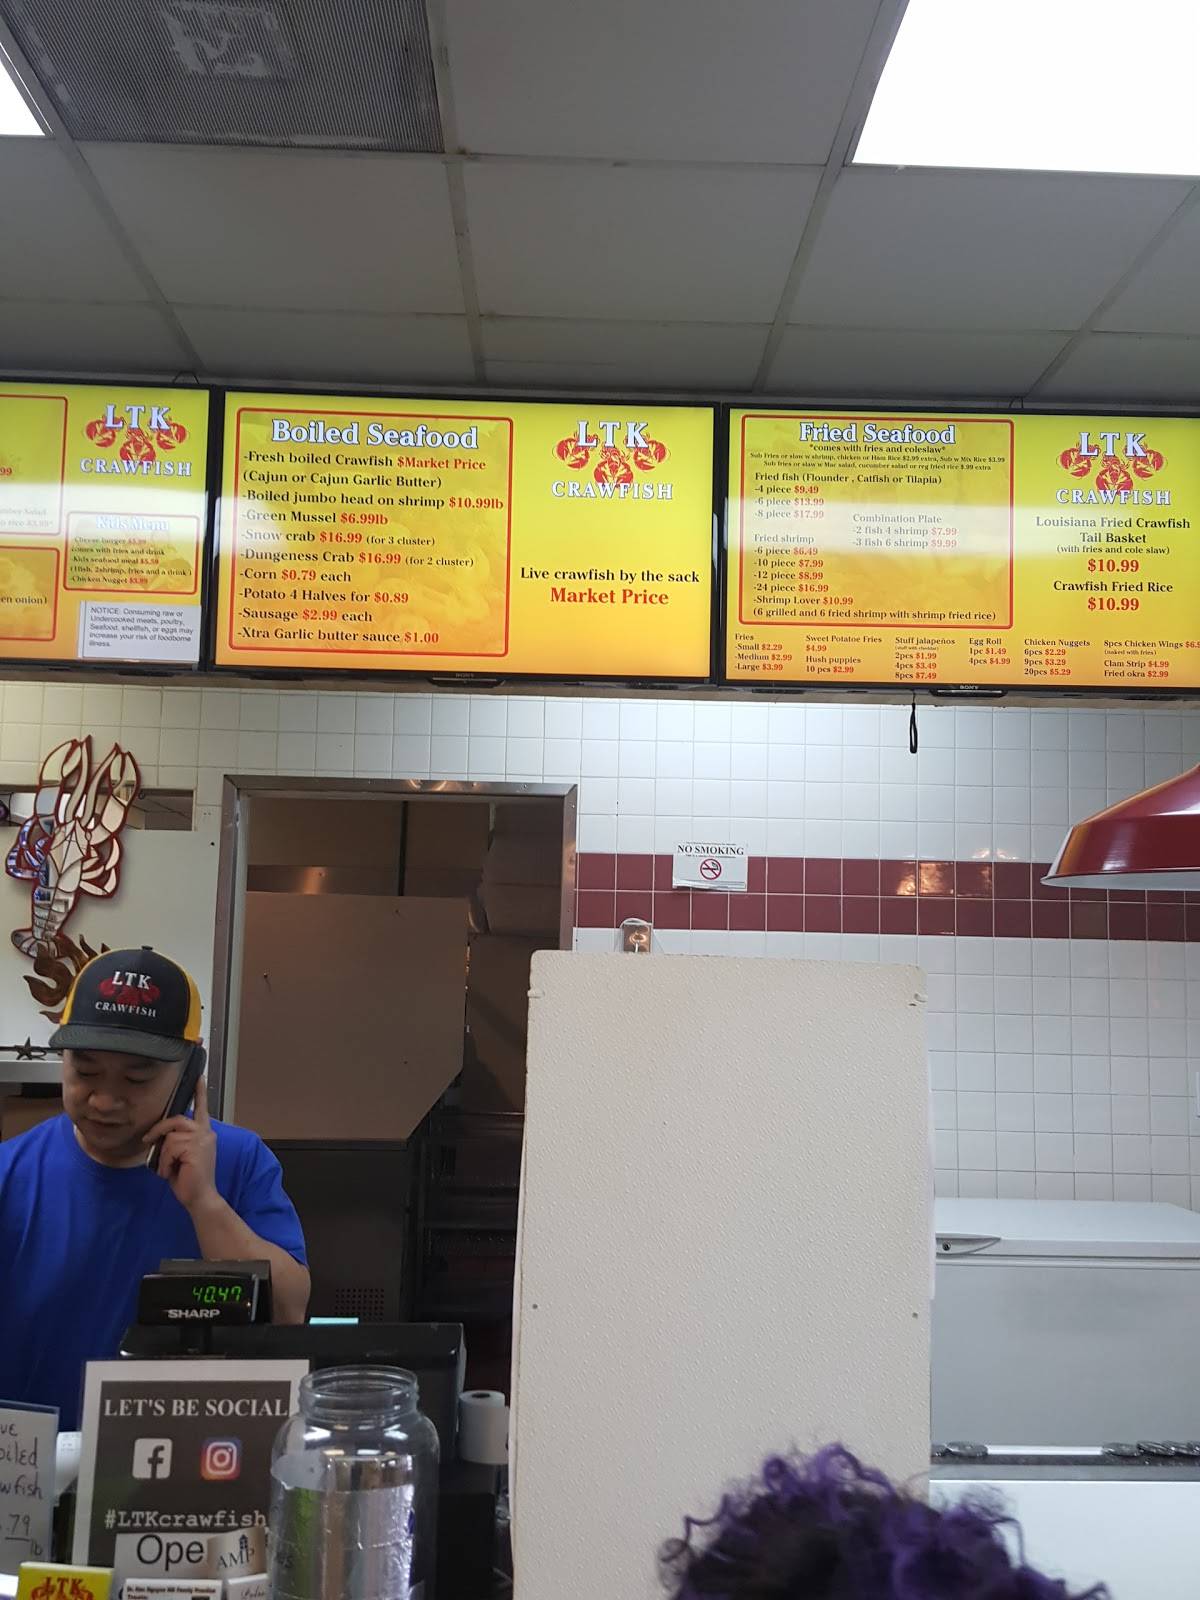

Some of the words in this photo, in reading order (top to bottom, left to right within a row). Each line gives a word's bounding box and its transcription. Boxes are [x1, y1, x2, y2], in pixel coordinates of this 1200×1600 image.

[105, 404, 172, 430] LTK
[272, 419, 359, 444] Boiled
[367, 424, 478, 449] Seafood
[576, 420, 650, 448] LTK
[800, 422, 857, 442] Fried
[863, 424, 956, 444] Seafood
[1080, 432, 1147, 458] LTK
[80, 458, 192, 476] CRAWFISH
[289, 452, 330, 463] boiled
[335, 454, 392, 466] Crawfish
[397, 456, 449, 469] $Market
[454, 457, 485, 469] Price
[243, 470, 287, 483] (Cajun
[291, 474, 306, 482] or
[310, 472, 348, 486] Cajun
[352, 473, 391, 486] Garlic
[396, 475, 441, 488] Butter)
[756, 472, 778, 480] Fried
[857, 474, 889, 482] Catfish
[907, 475, 941, 484] Tilapia)
[551, 480, 673, 500] CRAWFISH
[1056, 488, 1171, 505] CRAWFISH
[293, 491, 336, 503] jumbo
[341, 493, 372, 503] head
[398, 495, 444, 508] shrimp
[291, 510, 335, 523] Mussel
[852, 513, 914, 524] Combination
[918, 513, 941, 522] Plate
[1036, 516, 1096, 526] Louisiana
[1101, 517, 1132, 528] Fried
[1136, 517, 1190, 528] Crawfish
[286, 531, 314, 540] crab
[320, 531, 361, 542] $16.99
[397, 536, 434, 544] cluster)
[755, 533, 778, 544] Fried
[781, 534, 813, 544] shrimp
[1080, 532, 1100, 542] Tail
[1106, 533, 1145, 542] Basket
[1057, 544, 1079, 552] (with
[1146, 546, 1169, 555] slaw)
[323, 551, 354, 562] Crab
[358, 552, 401, 564] $16.99
[405, 557, 424, 565] (for
[427, 557, 432, 565] 2
[436, 558, 473, 567] cluster)
[1087, 559, 1139, 573] $10.99
[281, 569, 315, 580] $0.79
[320, 571, 350, 581] each
[521, 567, 549, 578] Live
[554, 568, 614, 580] crawfish
[620, 569, 636, 584] by
[641, 570, 663, 581] the
[668, 571, 699, 582] sack
[1053, 580, 1107, 590] Crawfish
[1112, 581, 1143, 591] Fried
[1148, 582, 1172, 591] Rice
[290, 589, 296, 599] 4
[302, 589, 345, 600] Halves
[351, 591, 370, 601] for
[374, 592, 408, 604] $0.89
[550, 587, 615, 603] Market
[622, 588, 669, 604] Price
[794, 596, 820, 604] Lover
[823, 596, 853, 604] $10.99
[1087, 597, 1139, 611] $10.99
[123, 608, 160, 617] Consuming
[302, 609, 336, 620] $2.99
[342, 611, 371, 621] each
[766, 608, 796, 616] grilled
[853, 608, 886, 619] shrimp
[889, 610, 909, 618] with
[912, 610, 945, 620] shrimp
[948, 611, 970, 619] fried
[974, 611, 995, 620] rice)
[274, 628, 313, 638] Garlic
[318, 629, 358, 640] butter
[404, 632, 438, 642] $1.00
[735, 633, 754, 641] Fries
[969, 637, 983, 646] Egg
[986, 637, 1001, 646] Roll
[1158, 640, 1182, 648] Wings
[678, 845, 692, 853] NO
[694, 846, 744, 855] SMOKING
[112, 971, 151, 990] LTK
[95, 1001, 156, 1018] CRAWFISH
[167, 1309, 220, 1318] SHARP
[103, 1399, 166, 1416] LET'S
[172, 1400, 198, 1416] BE
[204, 1400, 289, 1417] SOCIAL
[104, 1510, 267, 1529] #LTKcrawfish
[136, 1534, 204, 1572] Ope
[46, 1576, 84, 1591] LTK
